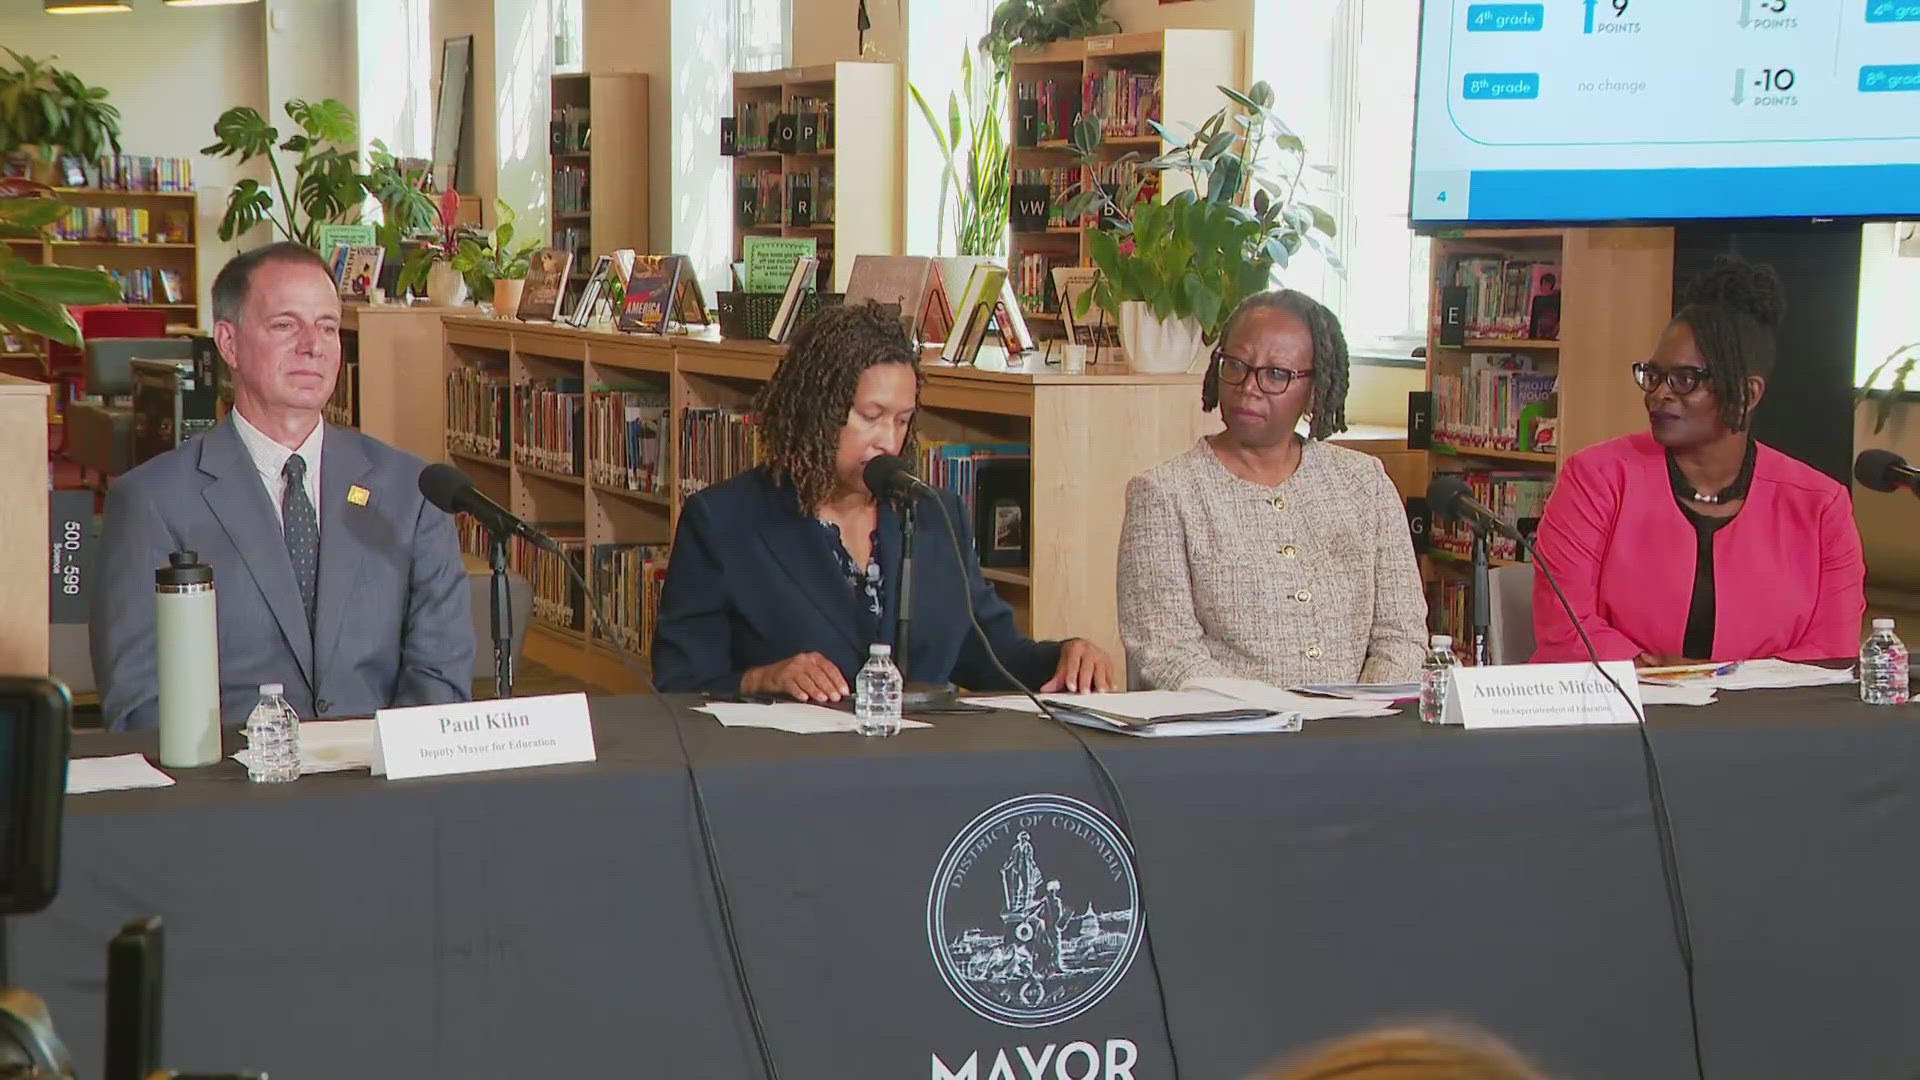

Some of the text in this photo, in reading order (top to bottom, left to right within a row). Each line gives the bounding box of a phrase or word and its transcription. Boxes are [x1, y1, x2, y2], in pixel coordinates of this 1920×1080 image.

[1613, 0, 1628, 17] 9
[1475, 10, 1535, 28] 4th grade
[1754, 18, 1798, 29] POINTS
[1598, 22, 1641, 33] POINTS
[1470, 78, 1531, 96] 8th grade
[1578, 78, 1647, 94] no change
[1754, 69, 1794, 91] -10
[1754, 96, 1798, 106] POINTS
[1023, 115, 1032, 131] T
[724, 130, 733, 144] H
[782, 127, 792, 140] O
[804, 127, 814, 140] P
[1437, 191, 1447, 202] 4
[743, 200, 753, 214] K
[798, 200, 807, 214] R
[1020, 200, 1044, 216] VW
[625, 301, 661, 315] AMERICA
[1448, 306, 1459, 324] E
[1415, 412, 1425, 429] F
[1411, 516, 1423, 534] G
[64, 521, 80, 550] 500
[63, 565, 80, 594] 599
[1473, 681, 1554, 699] Antoinette
[1511, 706, 1566, 717] Superintendent
[1577, 705, 1612, 713] Education
[438, 712, 530, 734] Paul Kihn
[420, 738, 557, 760] Deputy Mayor for Education
[951, 815, 1123, 888] DISTRICT OF COLUMBIA
[932, 1039, 1138, 1080] MAYOR
